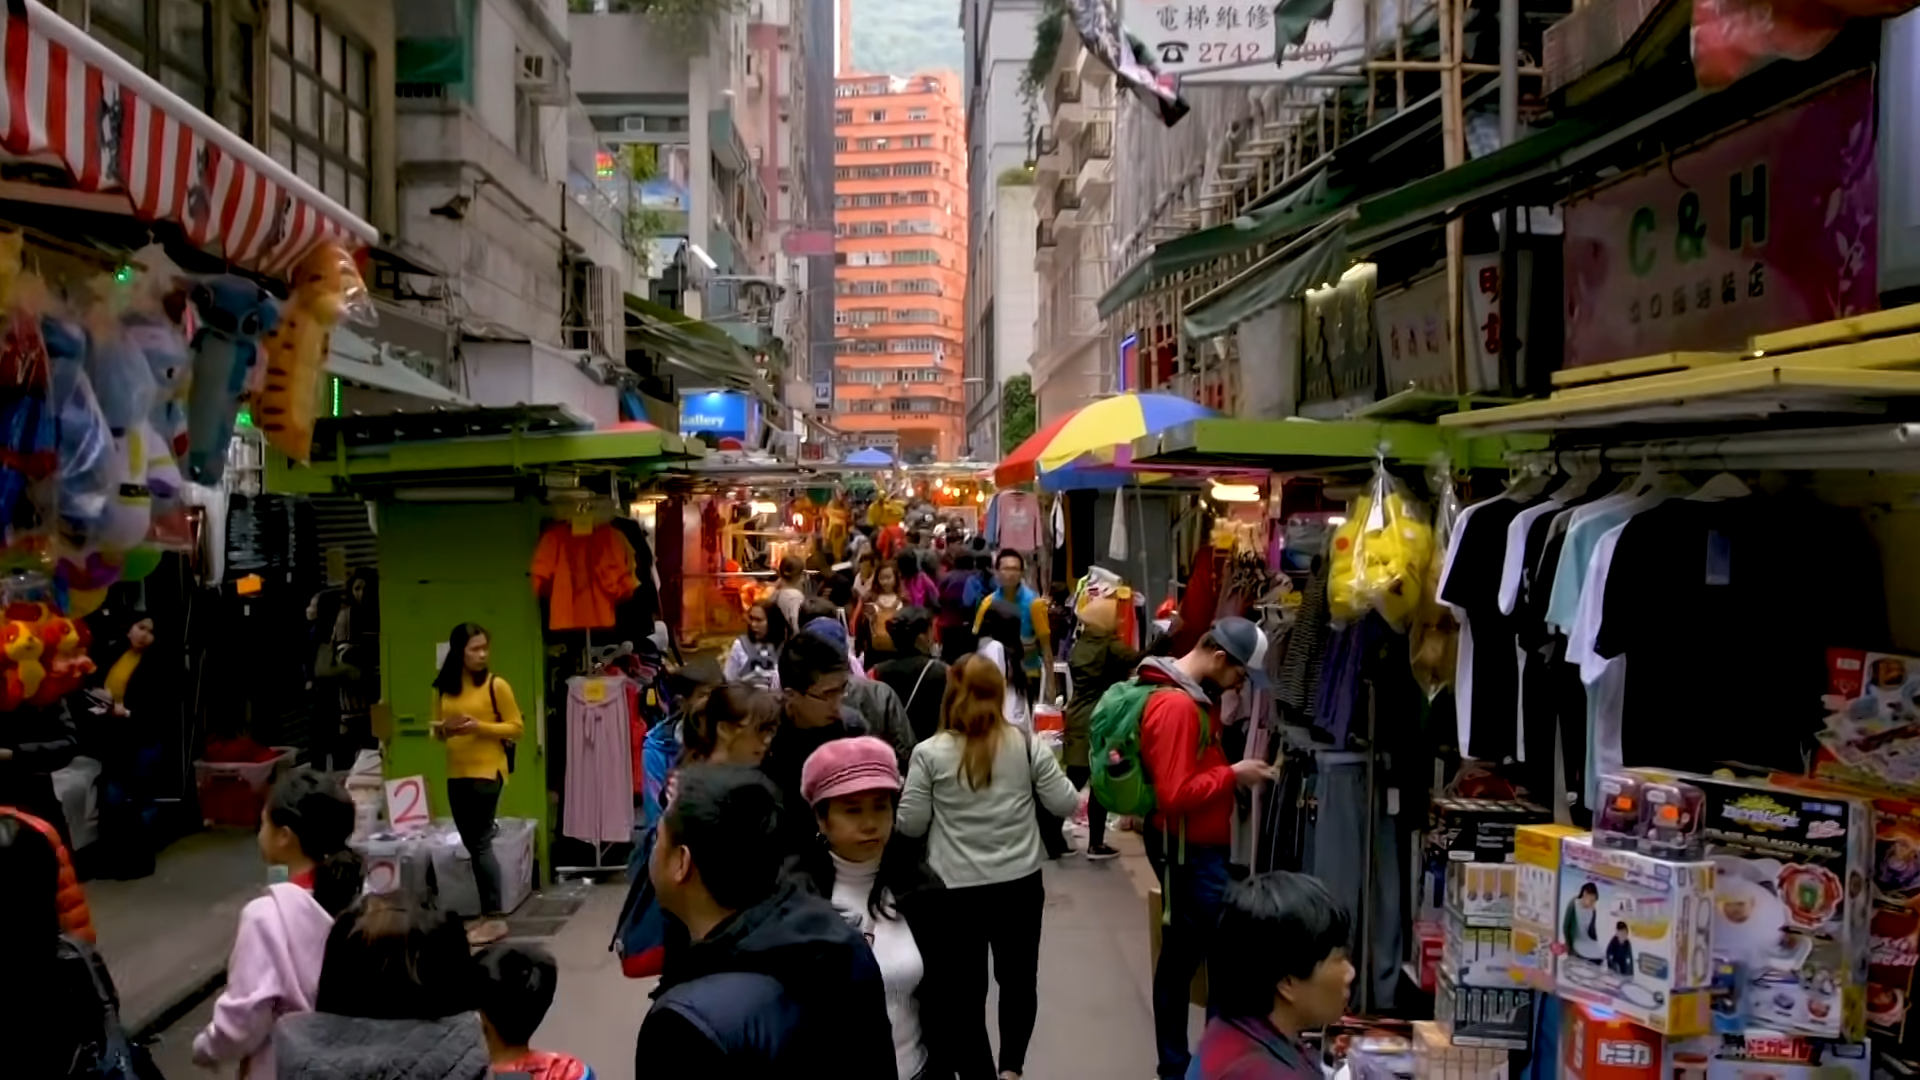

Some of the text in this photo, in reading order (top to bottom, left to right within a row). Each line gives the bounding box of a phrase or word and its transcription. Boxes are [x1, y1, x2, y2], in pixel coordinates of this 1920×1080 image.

[1198, 42, 1260, 63] 2742
[1628, 164, 1767, 277] C & H
[394, 780, 427, 823] 2
